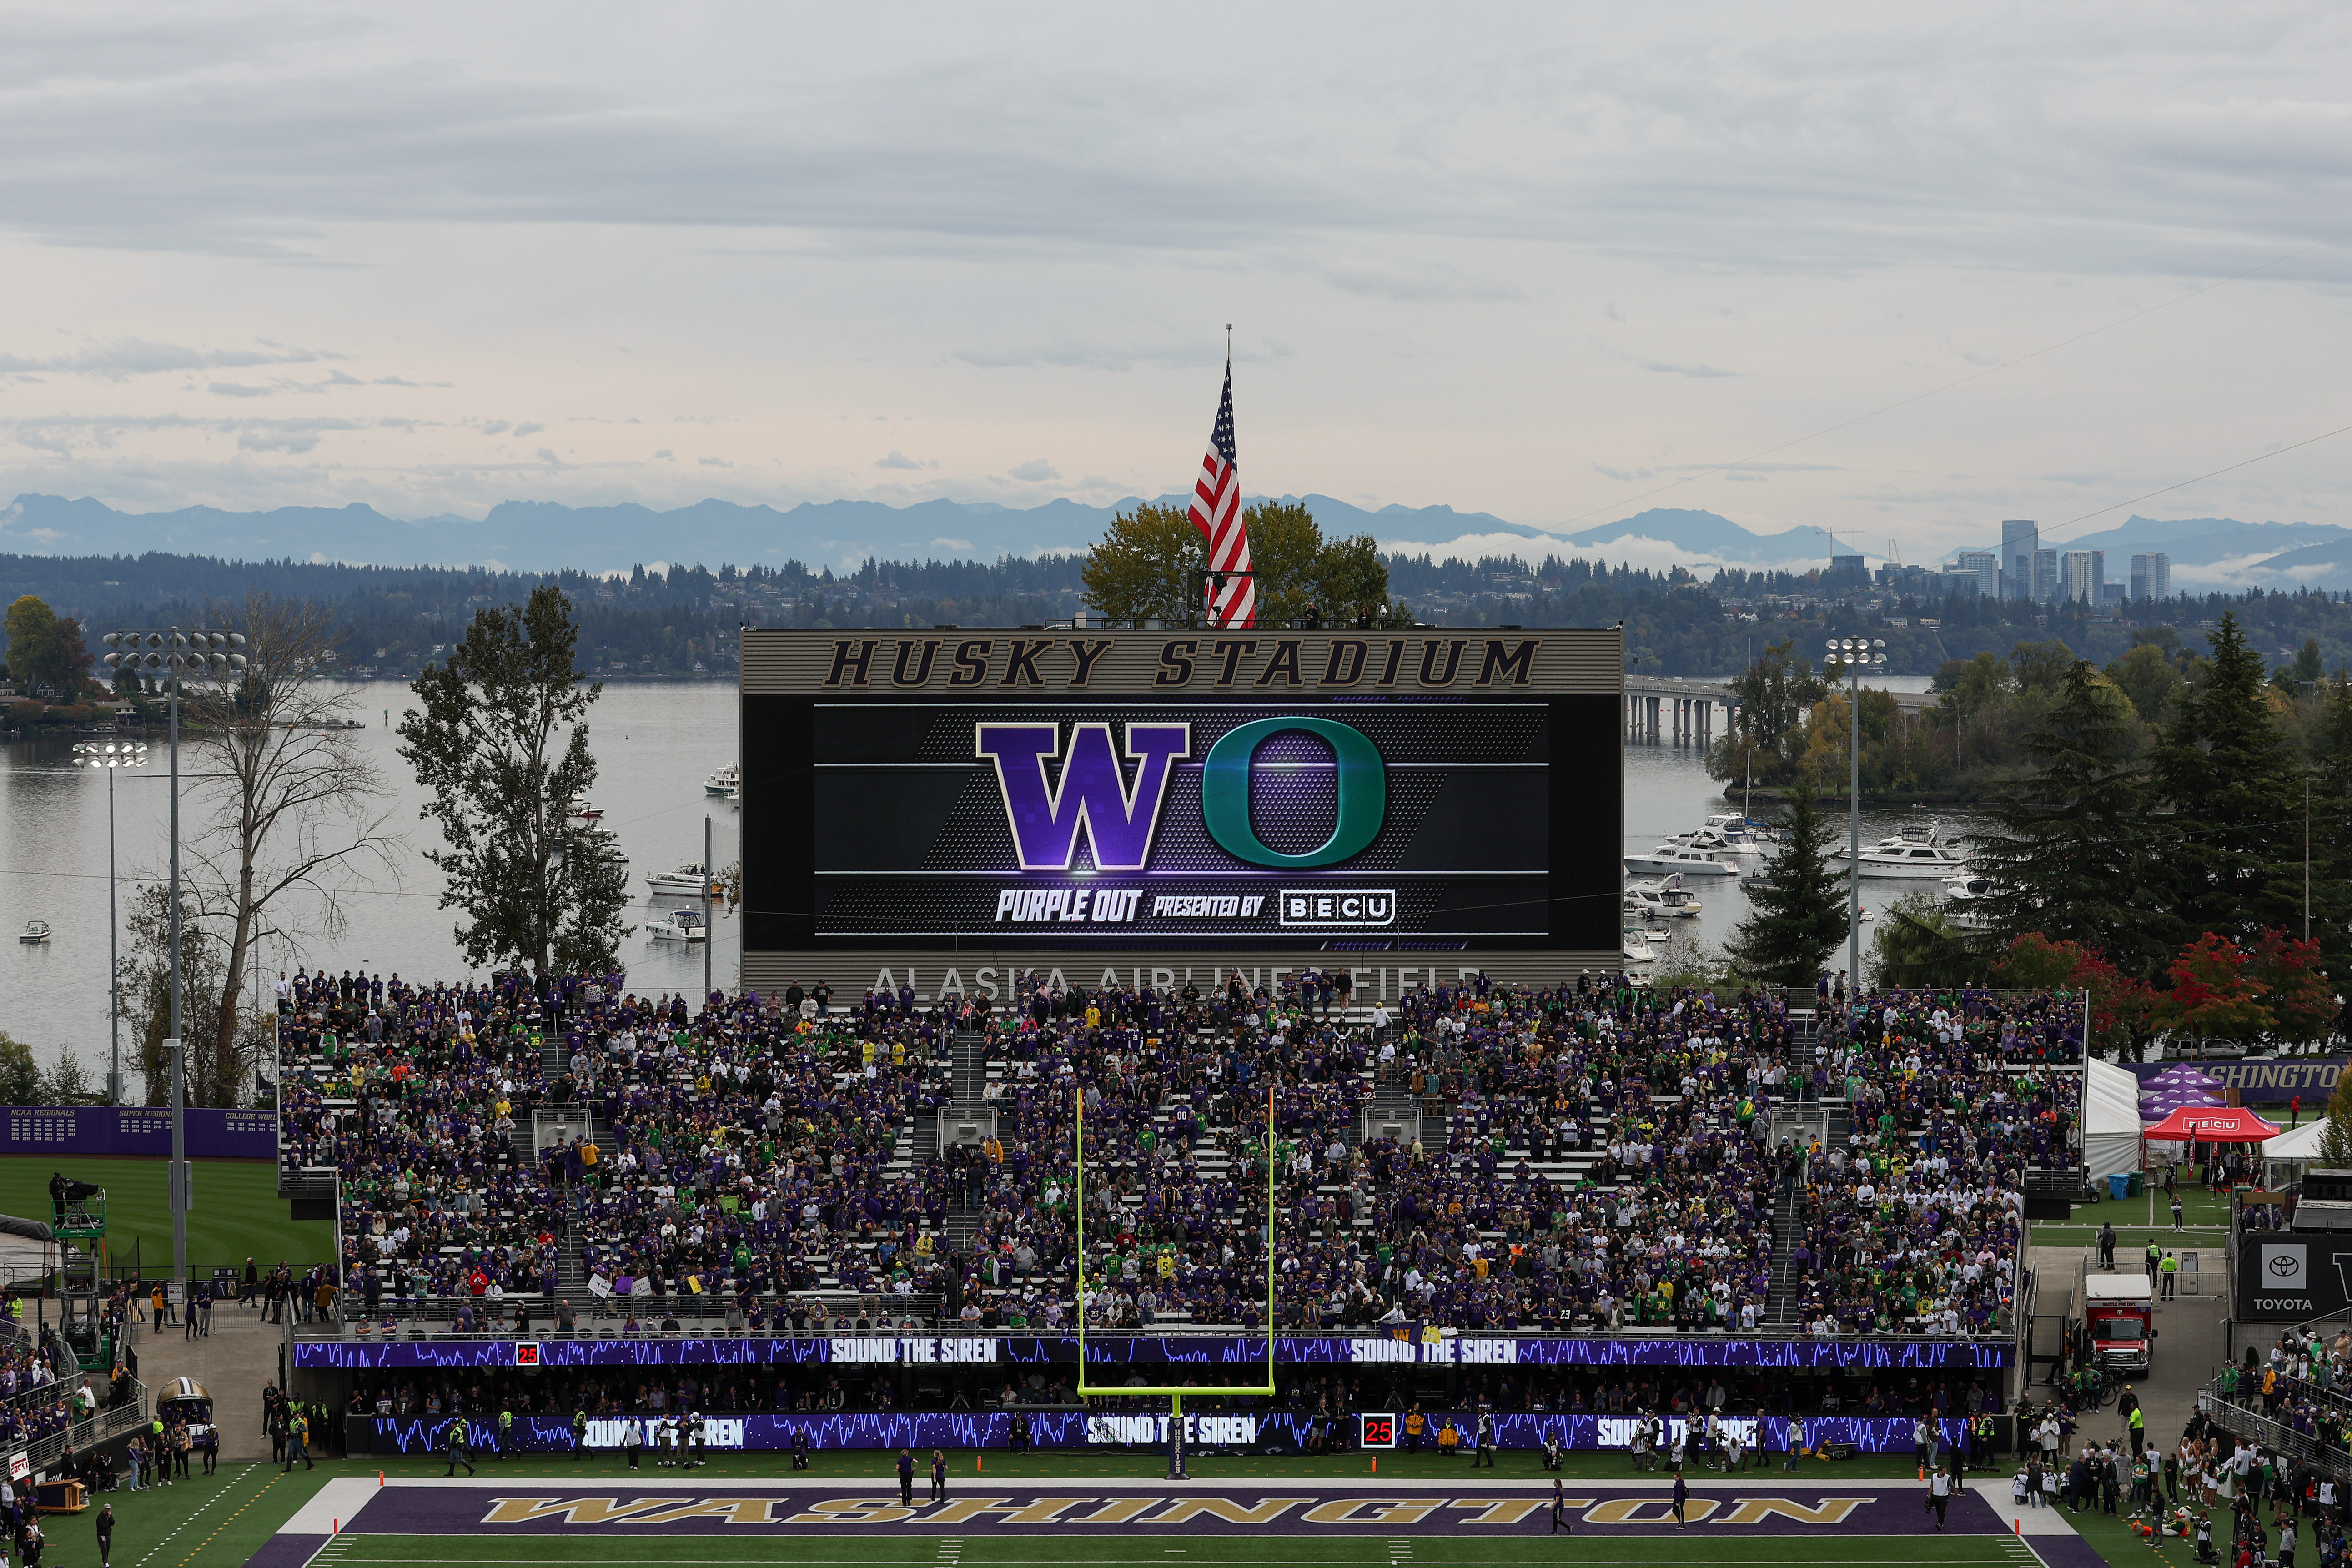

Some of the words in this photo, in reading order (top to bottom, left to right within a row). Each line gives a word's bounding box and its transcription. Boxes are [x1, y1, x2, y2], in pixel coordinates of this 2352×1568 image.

[821, 638, 1114, 688] HUSKY
[1152, 638, 1543, 688] STADIUM
[975, 721, 1190, 870] W
[1202, 716, 1386, 868] O
[995, 890, 1091, 922] PURPLE
[1091, 890, 1143, 922] OUT
[1152, 896, 1239, 917] PRESENTED
[1240, 896, 1265, 917] BY
[1290, 899, 1387, 917] BECU
[1112, 1013, 1115, 1022] 1
[2161, 1065, 2347, 1088] SHINGTO
[1177, 1111, 1186, 1120] 00
[1880, 1159, 1887, 1169] 10
[1938, 1162, 1940, 1171] 1
[759, 1208, 761, 1217] 1
[386, 1243, 387, 1252] 1
[1092, 1254, 1101, 1264] W
[1874, 1275, 1881, 1284] 10
[1926, 1275, 1930, 1283] 1
[2254, 1299, 2313, 1310] TOYOTA
[1560, 1310, 1570, 1319] 23
[1392, 1329, 1410, 1341] W
[519, 1347, 537, 1363] 25
[831, 1338, 895, 1362] SOUND
[901, 1338, 936, 1362] THE
[941, 1338, 996, 1362] SIREN
[1351, 1339, 1415, 1363] SOUND
[1423, 1339, 1455, 1363] THE
[1461, 1340, 1517, 1363] SIREN
[581, 1420, 634, 1447] OUN
[646, 1420, 678, 1447] TE
[1088, 1417, 1153, 1444] SOUND
[1157, 1417, 1194, 1444] TE
[1199, 1417, 1255, 1444] SIREN
[1366, 1422, 1392, 1441] 25
[1598, 1419, 1664, 1446] SOU
[480, 1498, 1878, 1524] WASHINGTON
